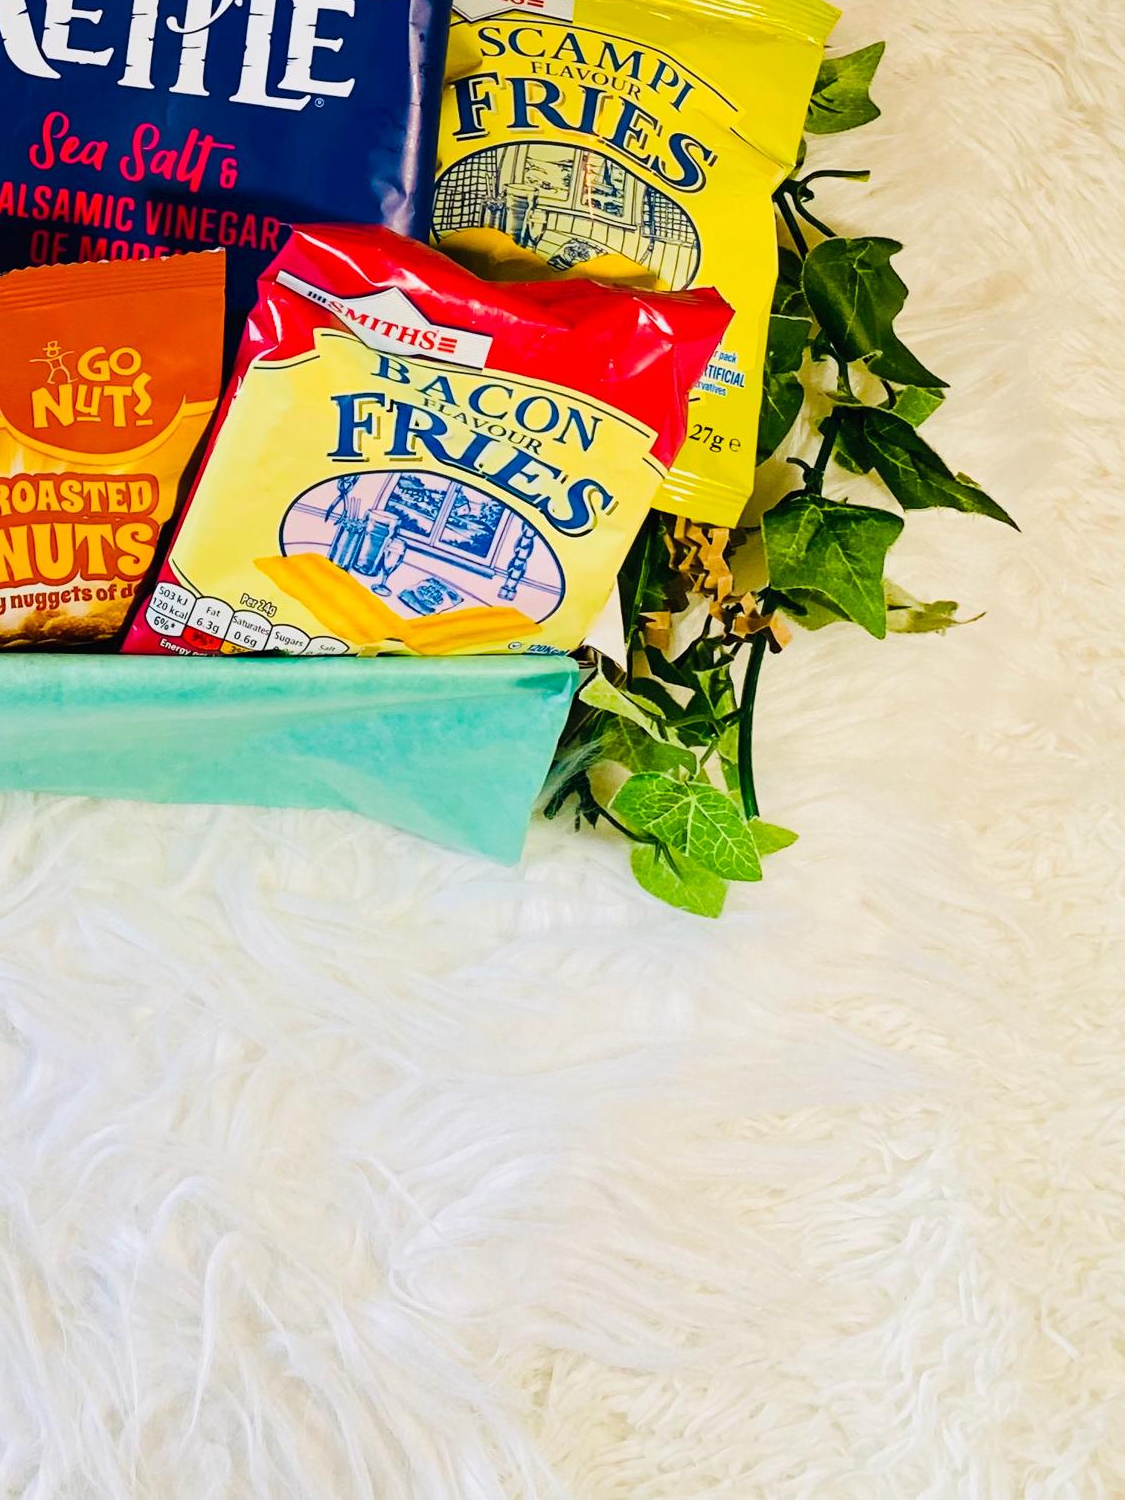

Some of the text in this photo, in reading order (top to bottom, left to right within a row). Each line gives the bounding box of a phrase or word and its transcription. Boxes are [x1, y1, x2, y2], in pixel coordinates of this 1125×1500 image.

[478, 26, 696, 113] SCAMPI
[530, 60, 643, 101] FLAVOUR
[451, 70, 720, 195] FRIES
[29, 111, 239, 194] Sea Salt &
[145, 200, 281, 252] VINEGAR
[30, 229, 70, 265] OF
[328, 300, 441, 352] SMITHS
[77, 346, 142, 382] GO
[719, 350, 737, 363] pack
[370, 353, 605, 454] BACON
[422, 398, 545, 456] FLAVOUR
[689, 423, 724, 453] 27g
[327, 392, 619, 539] FRIES
[10, 585, 93, 612] nuggets
[96, 584, 117, 601] of
[152, 597, 188, 621] 120 kcal
[158, 586, 188, 607] 503 kJ
[240, 593, 277, 618] Per 24g
[196, 618, 220, 634] 6.3g
[206, 606, 221, 618] Fat
[232, 615, 270, 636] Saturates
[160, 638, 192, 656] Energy
[234, 631, 258, 648] 0.6g
[275, 631, 304, 648] Sugars
